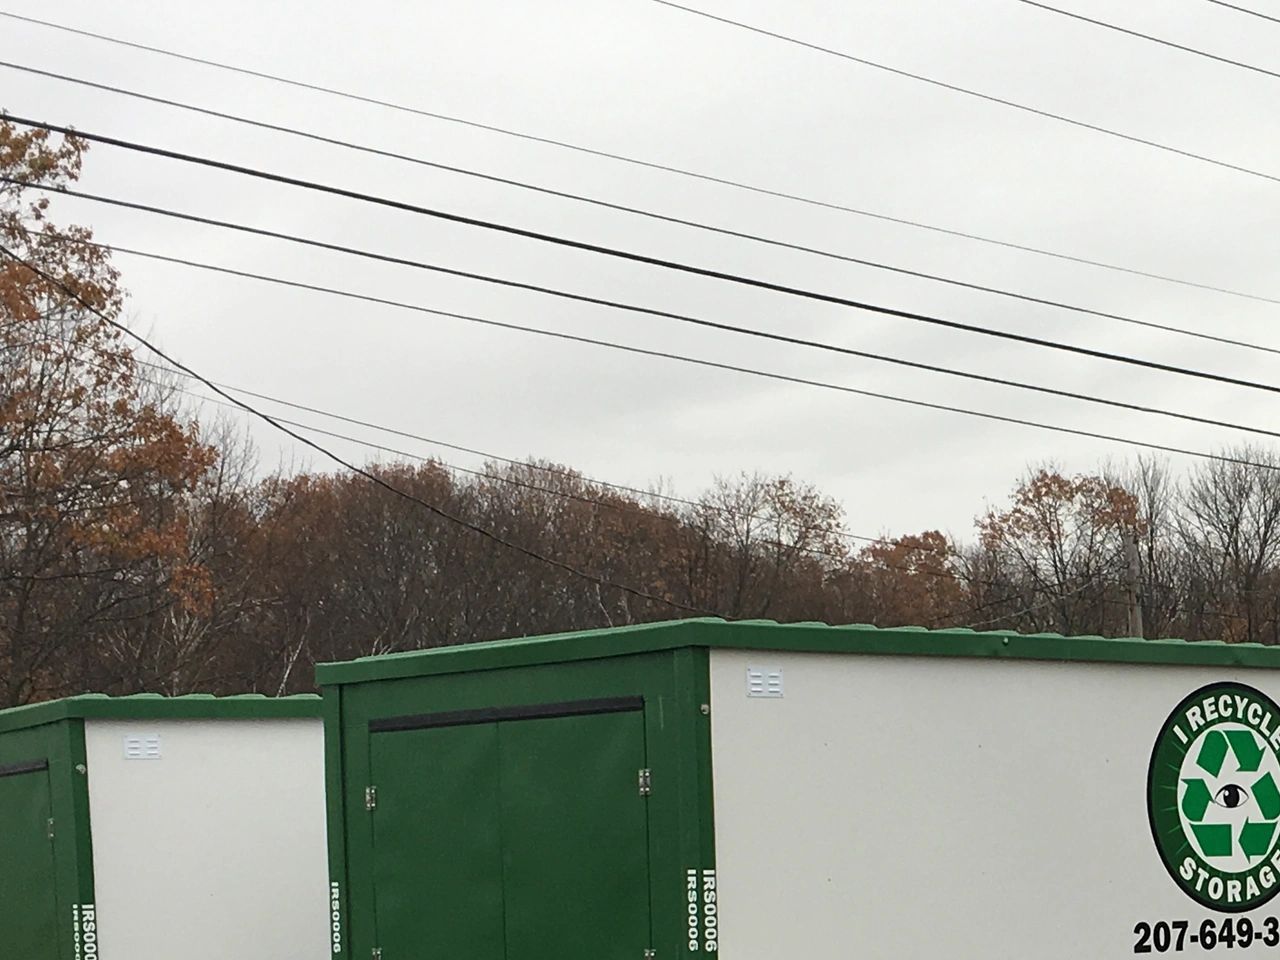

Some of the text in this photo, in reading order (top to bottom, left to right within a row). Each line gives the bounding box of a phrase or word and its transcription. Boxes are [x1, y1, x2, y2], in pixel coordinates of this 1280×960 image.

[1173, 725, 1188, 744] I
[331, 882, 341, 952] IRS0006
[687, 869, 698, 951] IRS0006
[703, 869, 717, 952] IRS0006
